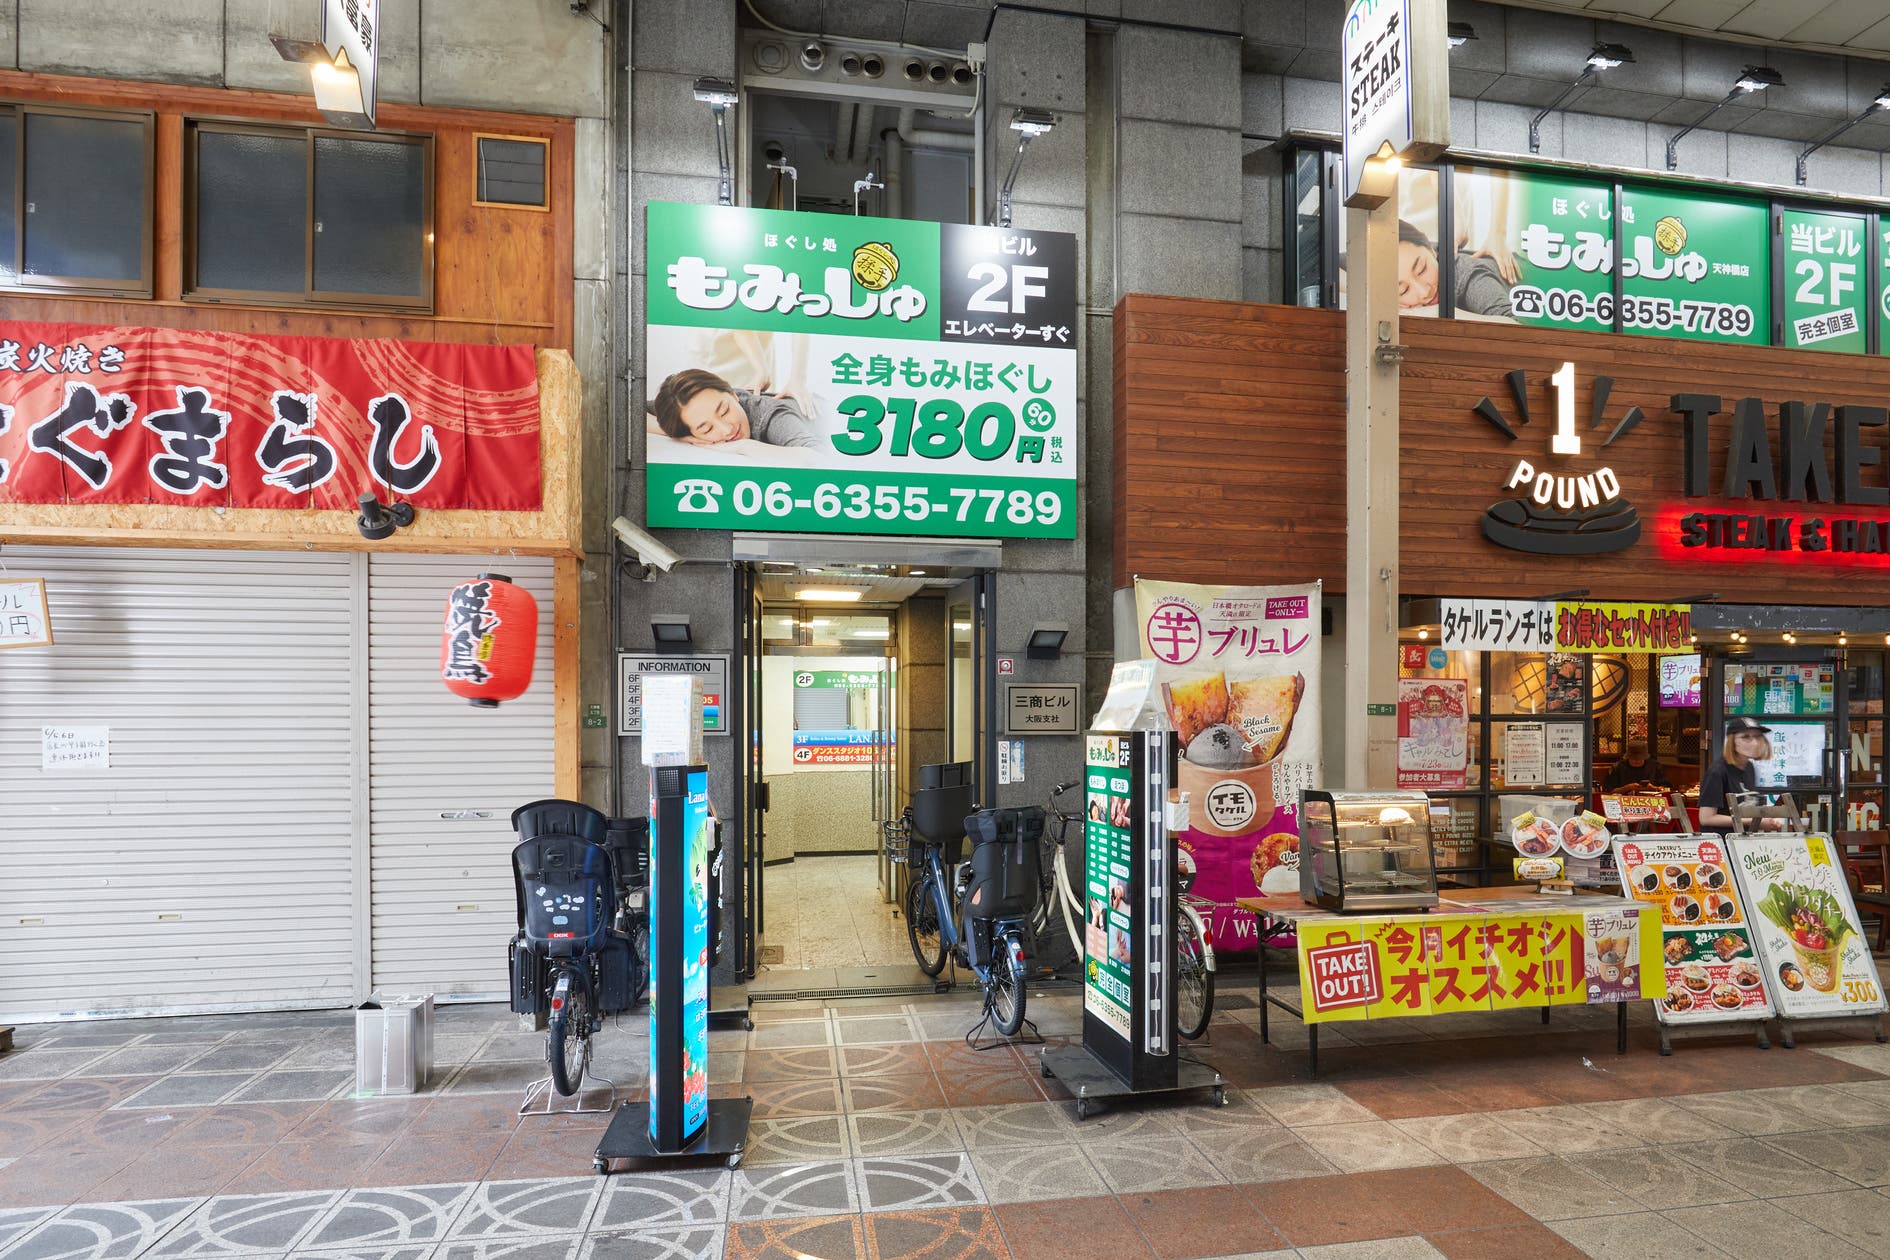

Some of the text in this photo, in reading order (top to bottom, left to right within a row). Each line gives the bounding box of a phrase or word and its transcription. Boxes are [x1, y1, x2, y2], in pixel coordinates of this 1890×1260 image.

[1351, 11, 1399, 79] ステーキ
[1351, 38, 1400, 118] STEAK
[1552, 197, 1635, 224] ほぐし処
[764, 232, 838, 253] ほぐし処
[983, 234, 1037, 256] ビル
[1791, 223, 1861, 257] 当ビル
[1521, 223, 1708, 283] もみっしゅ
[1712, 262, 1750, 278] 天神橋店
[1795, 259, 1856, 306] 2F
[667, 256, 927, 321] もみっしゅ
[967, 262, 1048, 314] 2F
[1549, 291, 1752, 333] 06-6355-7789
[945, 320, 1070, 343] エレベーターすぐ
[1798, 312, 1856, 341] 完全個室
[0, 339, 126, 374] 炭火焼き
[831, 352, 1053, 394] 全身もみほぐし
[1551, 362, 1581, 455] 1
[0, 381, 442, 495] ぐまらし
[1051, 436, 1063, 463] 税込
[1508, 459, 1621, 509] POUND
[733, 481, 1062, 525] 06-6355-7789
[1680, 512, 1890, 555] STEAK & HA
[0, 615, 30, 635] 円
[1152, 611, 1197, 661] 芋
[1444, 606, 1691, 650] タケルランチは お得なセット付き!!
[1208, 625, 1309, 658] ブリュレ
[628, 674, 640, 682] 6F
[638, 662, 711, 672] INFORMATION
[798, 675, 812, 684] 2F
[628, 685, 640, 693] 5F
[628, 696, 640, 705] 4F
[1015, 695, 1070, 708] 三商ビル
[628, 706, 640, 715] 3F
[628, 717, 640, 726] 2F
[1025, 714, 1060, 723] 大阪支社
[1243, 714, 1271, 728] Black
[796, 735, 808, 743] 3F
[1248, 724, 1281, 738] Sesame
[797, 751, 810, 759] 4F
[1120, 751, 1130, 766] 2F
[1213, 792, 1245, 805] イモ
[1215, 806, 1247, 815] タケル
[1744, 852, 1771, 869] New
[1588, 918, 1637, 937] 芋 ブリュレ
[1385, 922, 1566, 964] 今月イチオシ
[1317, 952, 1367, 977] TAKE
[1321, 973, 1370, 999] OUT!
[1390, 959, 1566, 1009] オススメ!!
[1840, 980, 1878, 1004] ¥300
